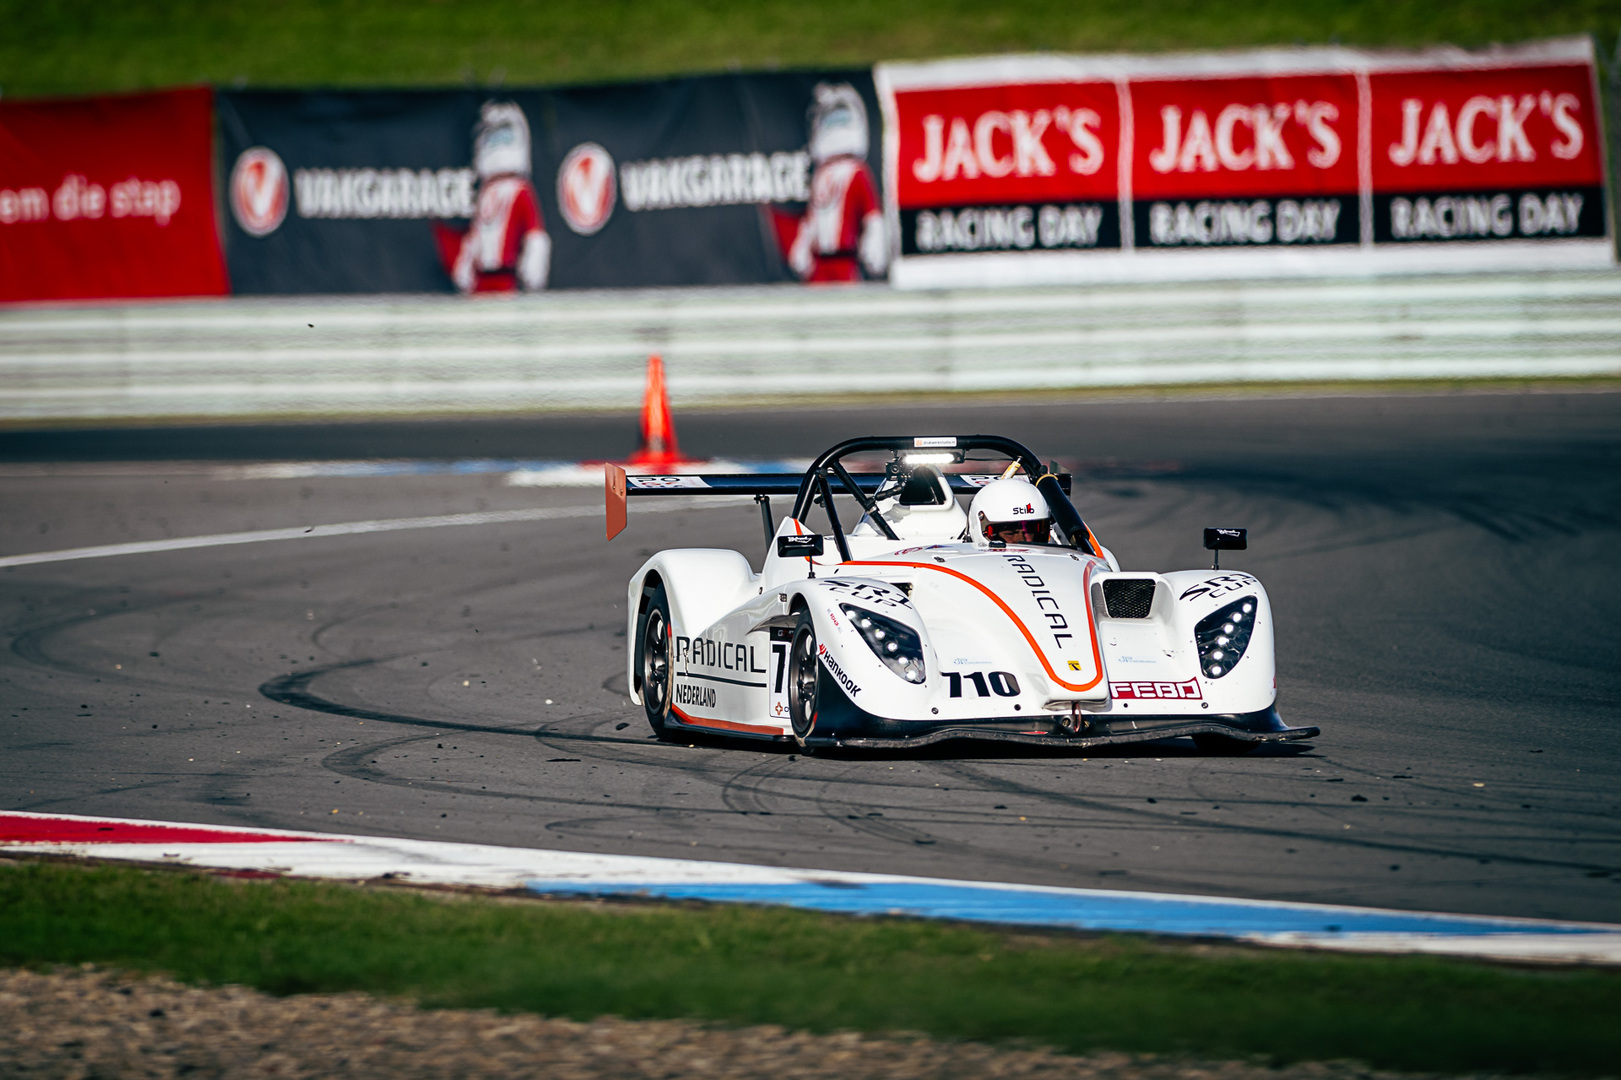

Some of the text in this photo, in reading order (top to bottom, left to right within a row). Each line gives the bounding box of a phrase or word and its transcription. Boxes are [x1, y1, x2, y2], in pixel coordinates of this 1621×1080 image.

[913, 105, 1105, 183] JACK'S
[1150, 99, 1342, 173] JACK'S
[1389, 91, 1584, 167] JACK'S
[53, 174, 106, 221] die
[109, 175, 181, 226] stap
[295, 168, 474, 218] VAKGARAGE
[620, 152, 811, 211] VAKGARAGE
[916, 204, 1103, 250] RACING DAY
[1150, 199, 1340, 244] RACING DAY
[1391, 193, 1583, 238] RACING DAY
[1012, 503, 1035, 515] Stilo
[1002, 554, 1073, 650] RADICAL
[676, 636, 767, 674] RADICAL
[675, 683, 717, 708] NEDERLAND
[1109, 679, 1201, 698] FEBO
